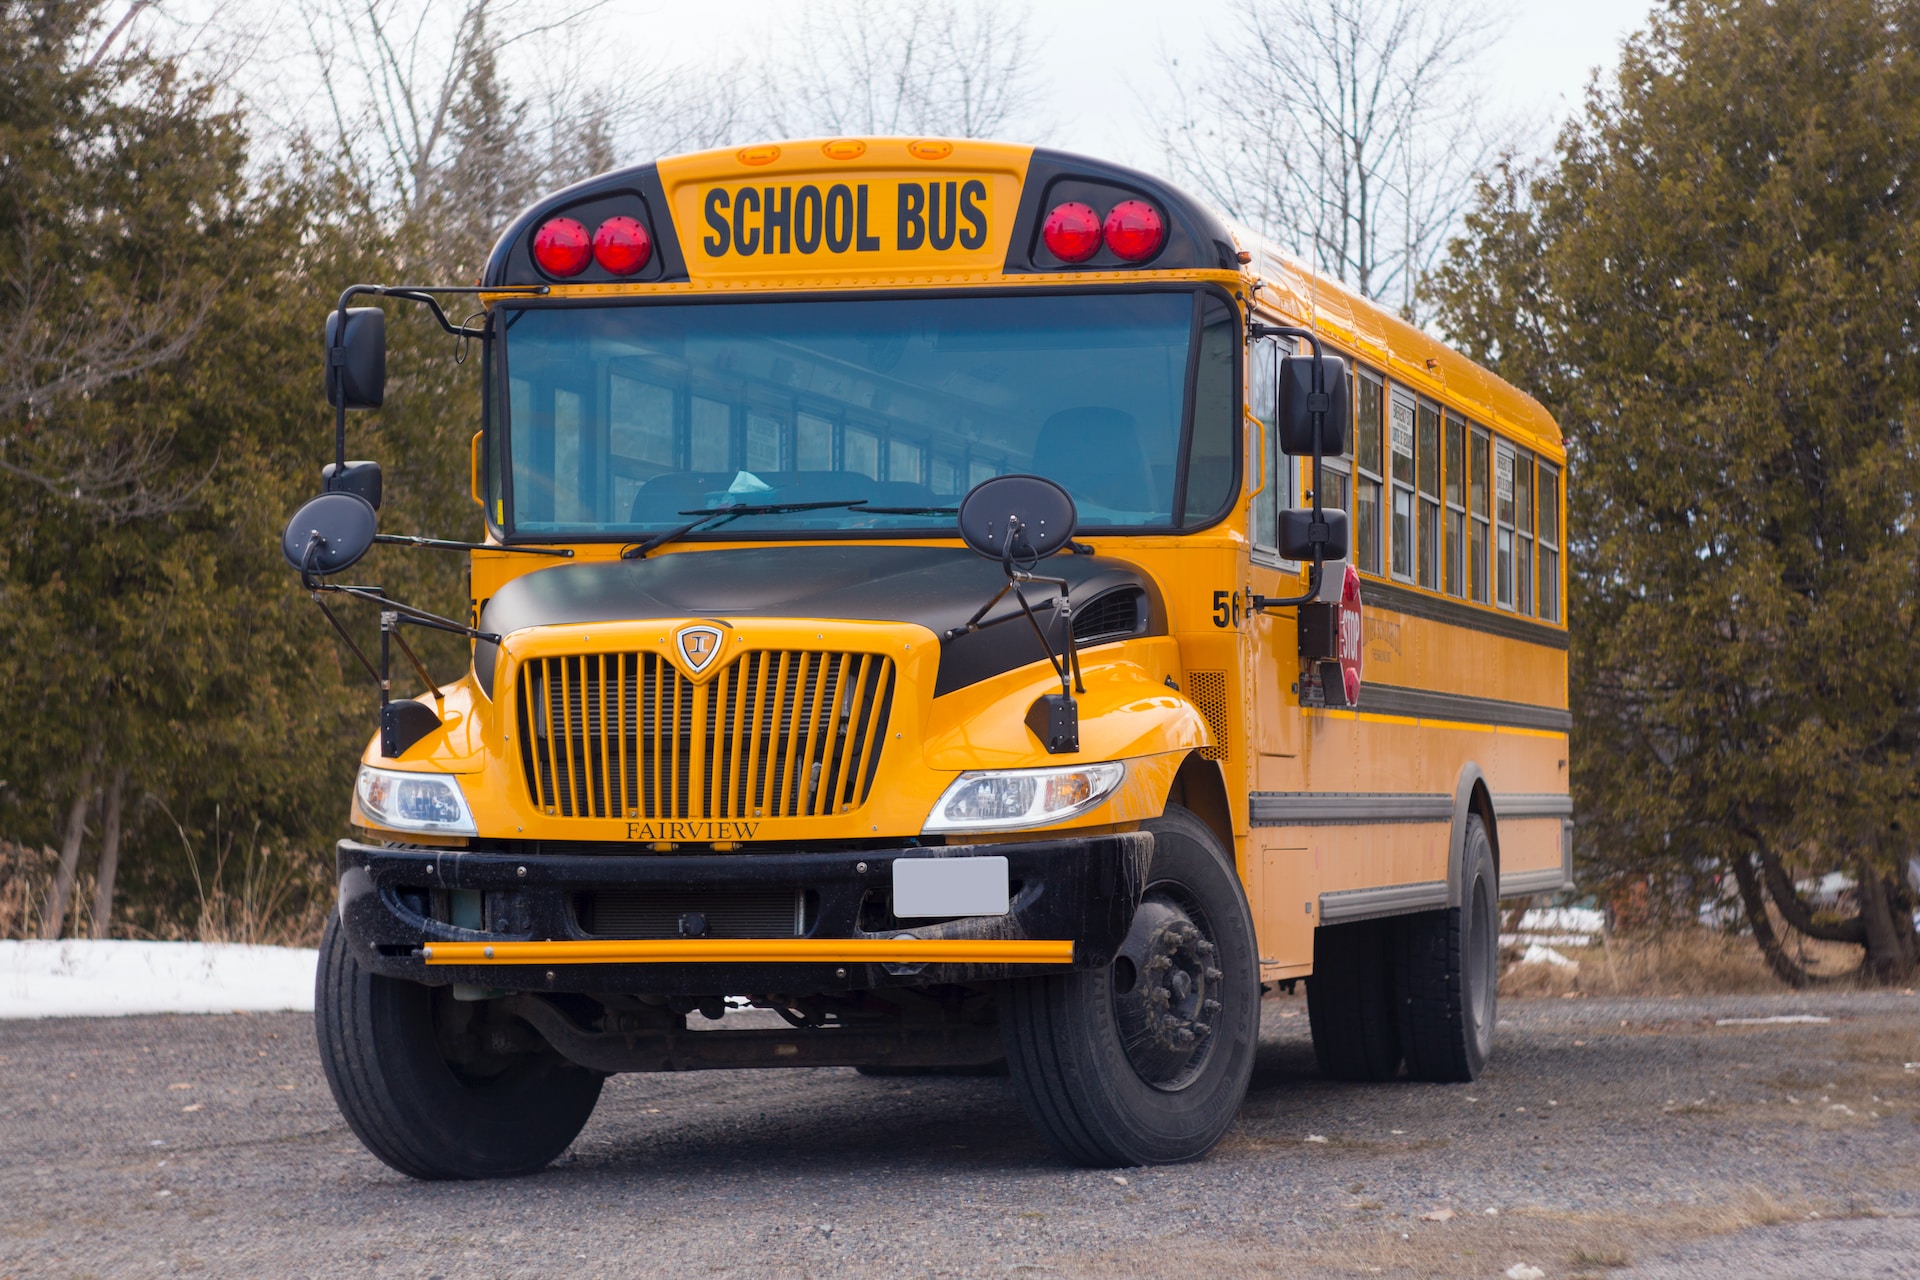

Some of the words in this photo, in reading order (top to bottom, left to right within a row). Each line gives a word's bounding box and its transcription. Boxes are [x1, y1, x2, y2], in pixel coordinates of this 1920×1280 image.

[703, 184, 880, 257] SCHOOL
[897, 179, 988, 251] BUS
[1342, 609, 1360, 662] STOP
[626, 821, 760, 840] FAIRVIEW
